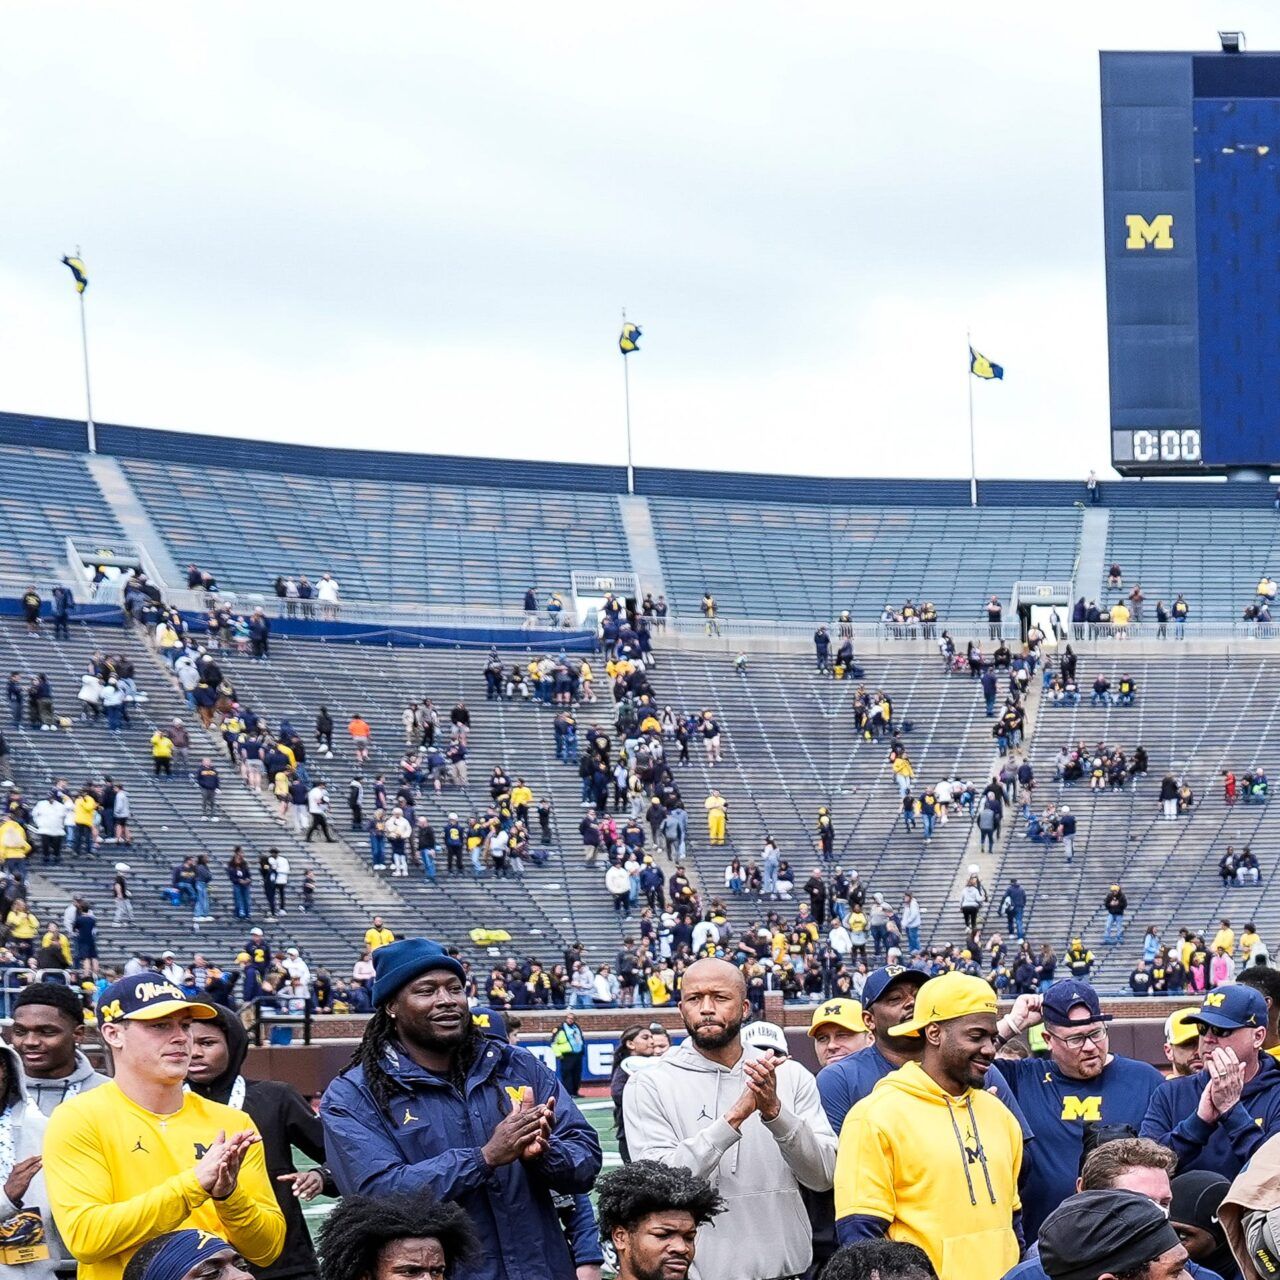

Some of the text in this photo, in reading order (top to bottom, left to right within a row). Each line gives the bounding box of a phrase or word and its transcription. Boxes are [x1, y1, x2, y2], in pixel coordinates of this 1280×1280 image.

[1125, 214, 1174, 250] M
[1133, 430, 1200, 461] 0:00
[100, 999, 125, 1023] M
[824, 1005, 843, 1016] M
[1205, 992, 1226, 1008] M
[472, 1014, 490, 1028] M
[1061, 1096, 1102, 1121] M
[1255, 1248, 1277, 1274] Nikon
